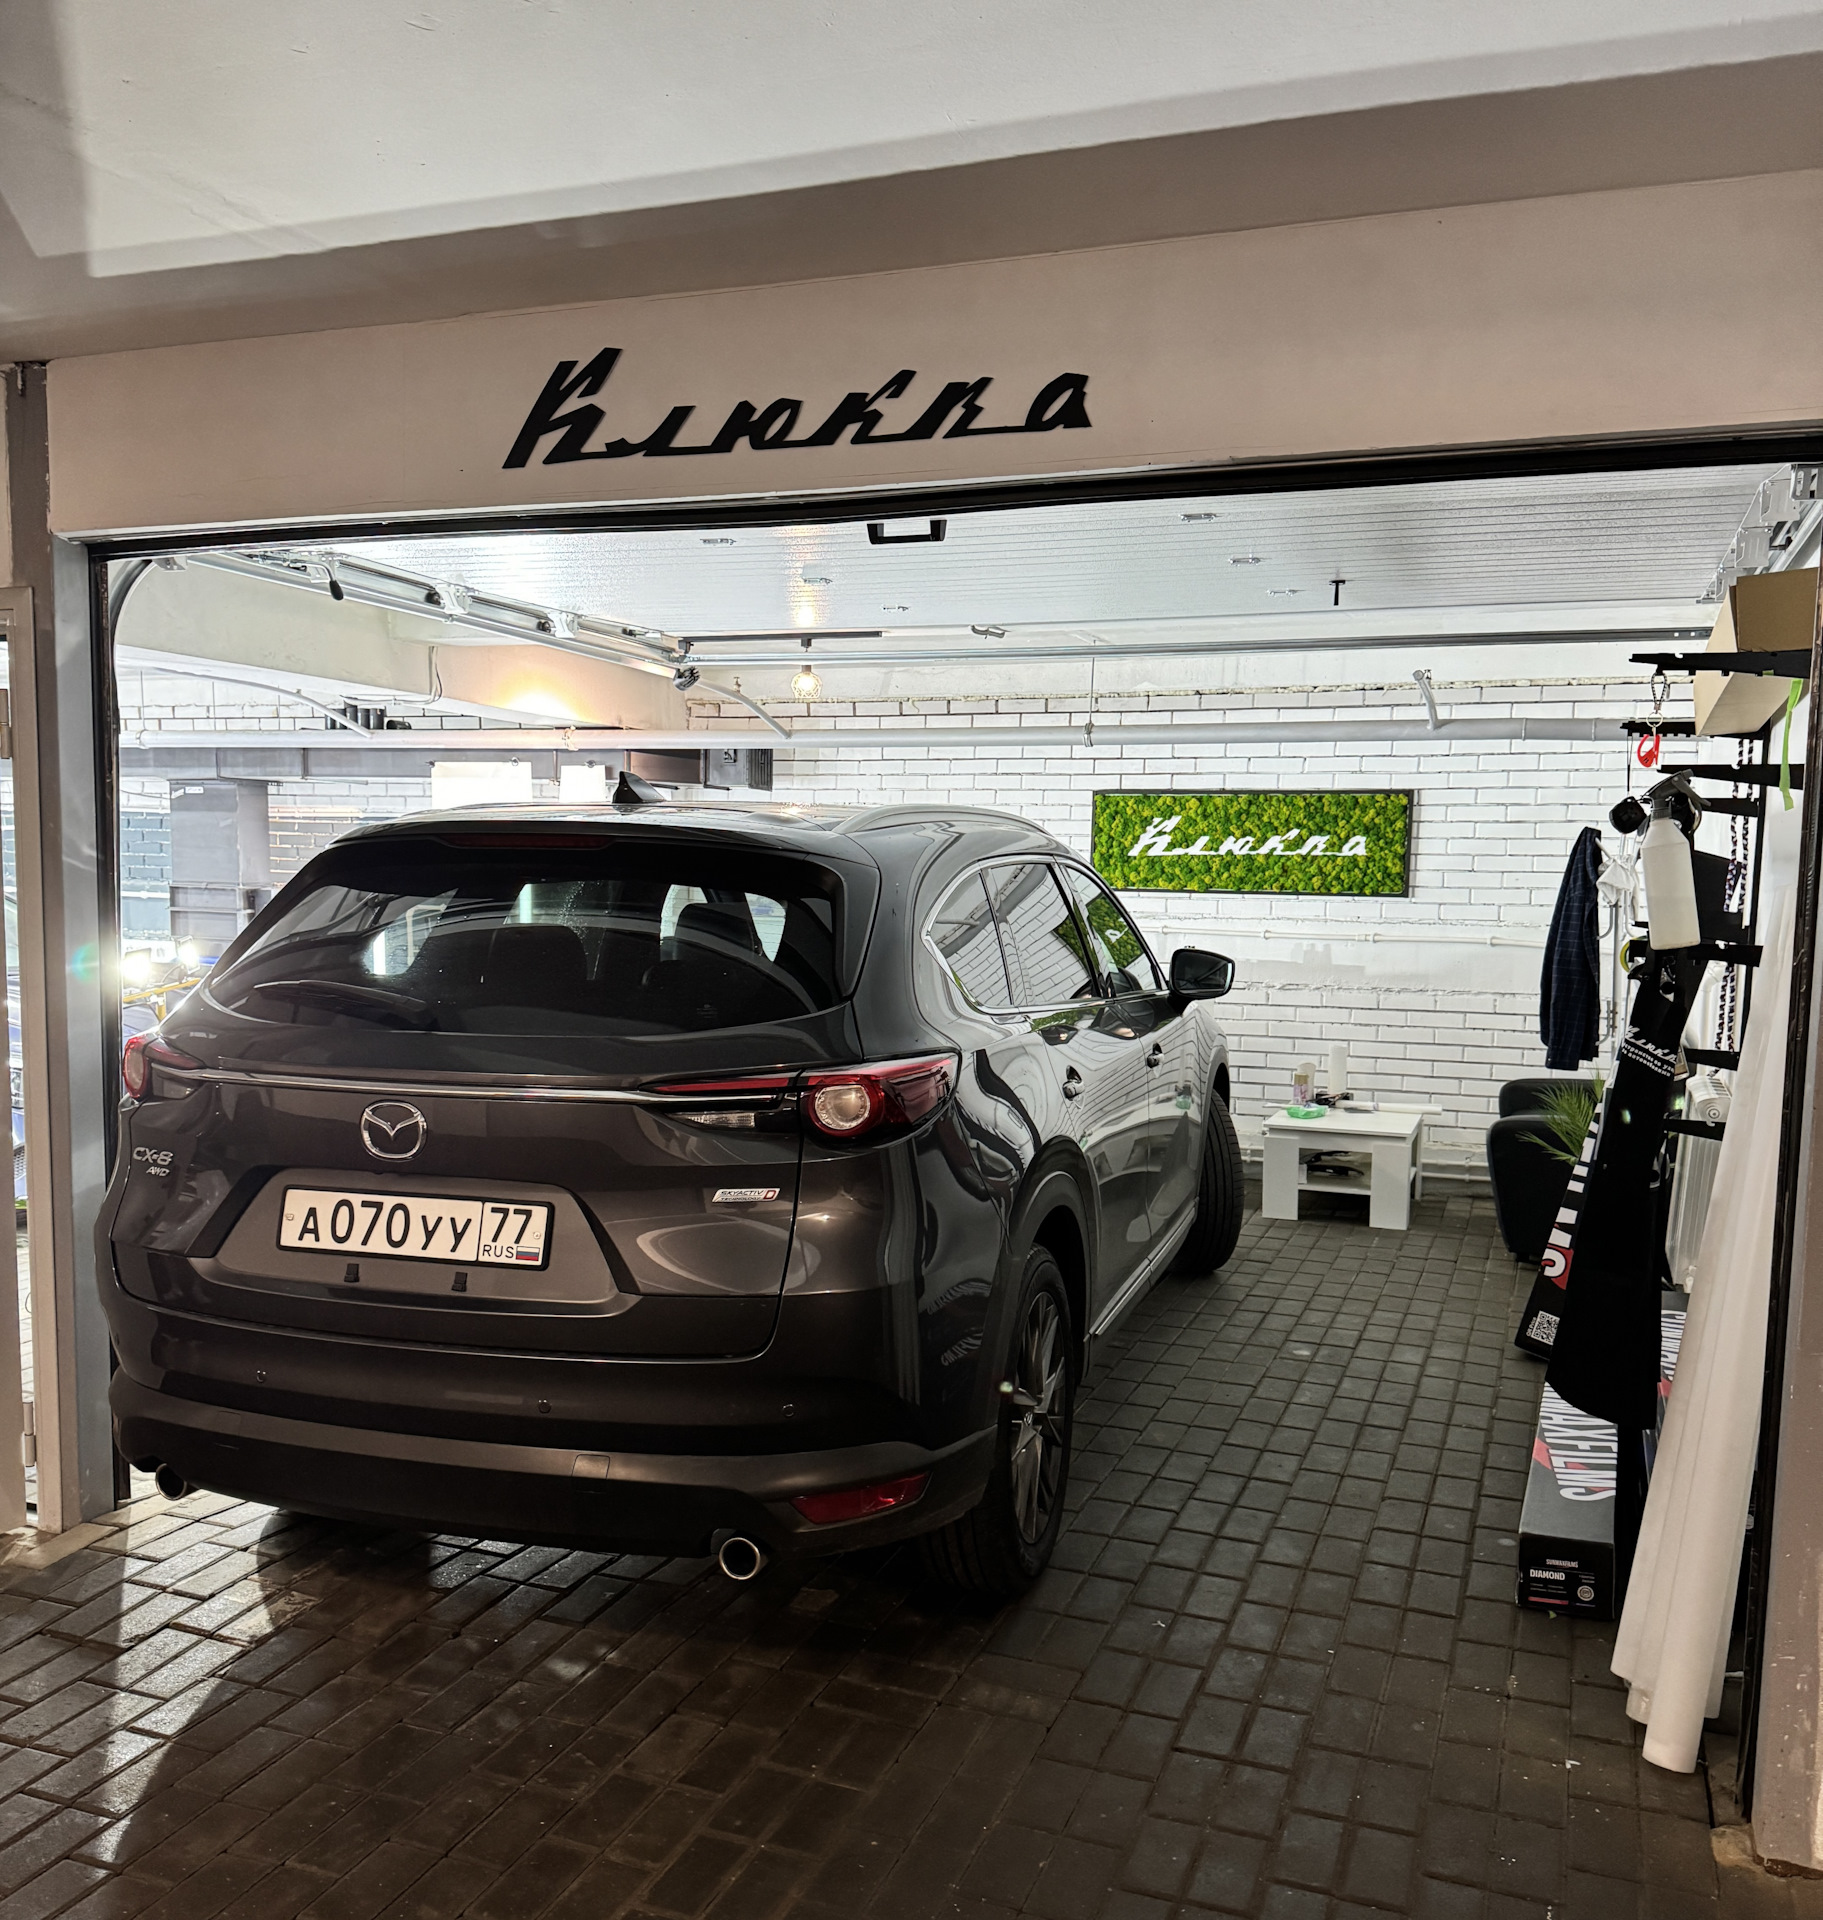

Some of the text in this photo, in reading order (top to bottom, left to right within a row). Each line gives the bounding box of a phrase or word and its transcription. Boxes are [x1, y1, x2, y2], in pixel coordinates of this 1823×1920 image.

[502, 347, 1092, 469] Клюква
[1127, 815, 1367, 857] Клюква
[133, 1146, 174, 1165] CX-8
[146, 1166, 170, 1177] AWD
[297, 1197, 533, 1254] А070УУ 77
[482, 1244, 516, 1260] RUS
[1529, 1568, 1566, 1581] DIAMOND
